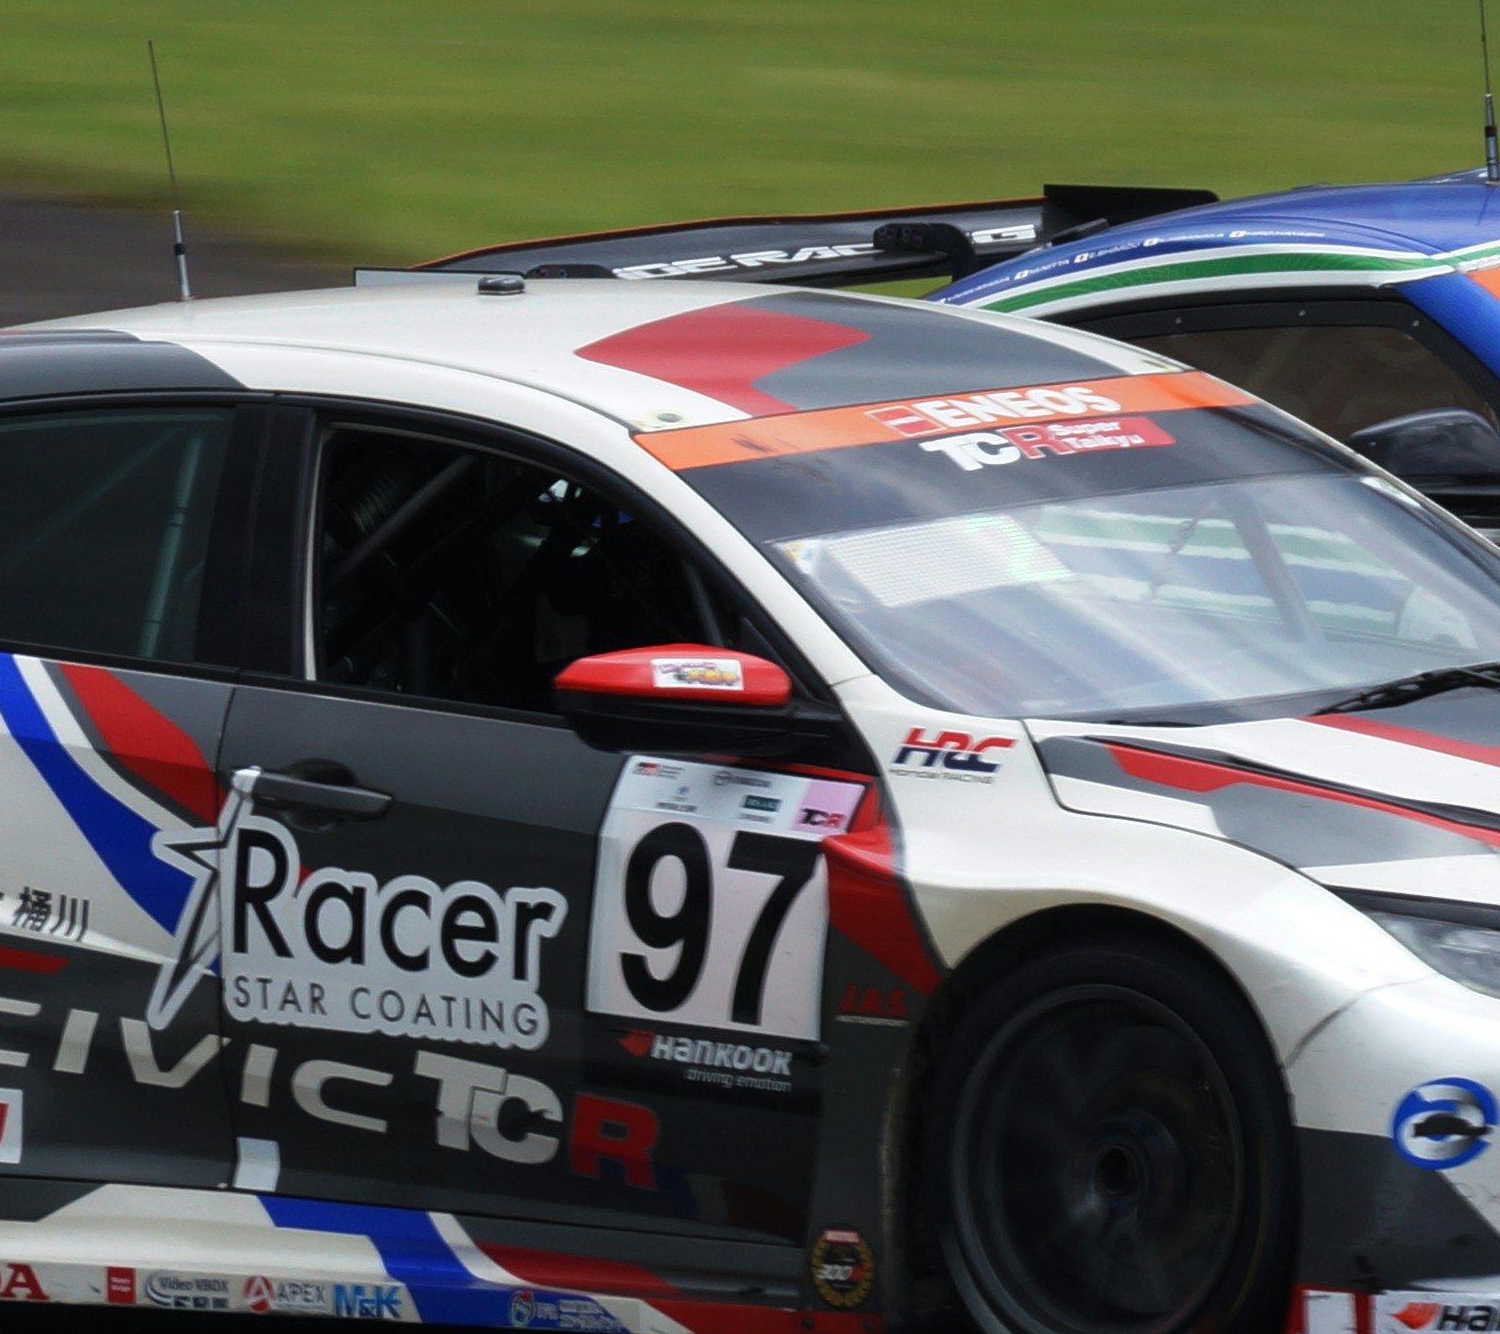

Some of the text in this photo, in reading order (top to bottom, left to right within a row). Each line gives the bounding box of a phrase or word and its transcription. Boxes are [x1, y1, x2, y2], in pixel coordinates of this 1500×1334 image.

[913, 387, 1121, 429] ENEOS
[919, 420, 1122, 471] TCR Super
[233, 827, 557, 981] Racer
[617, 822, 826, 1026] 97
[233, 976, 540, 1036] STAR COATING
[686, 1068, 793, 1092] driving emotion
[414, 1049, 661, 1191] TCR
